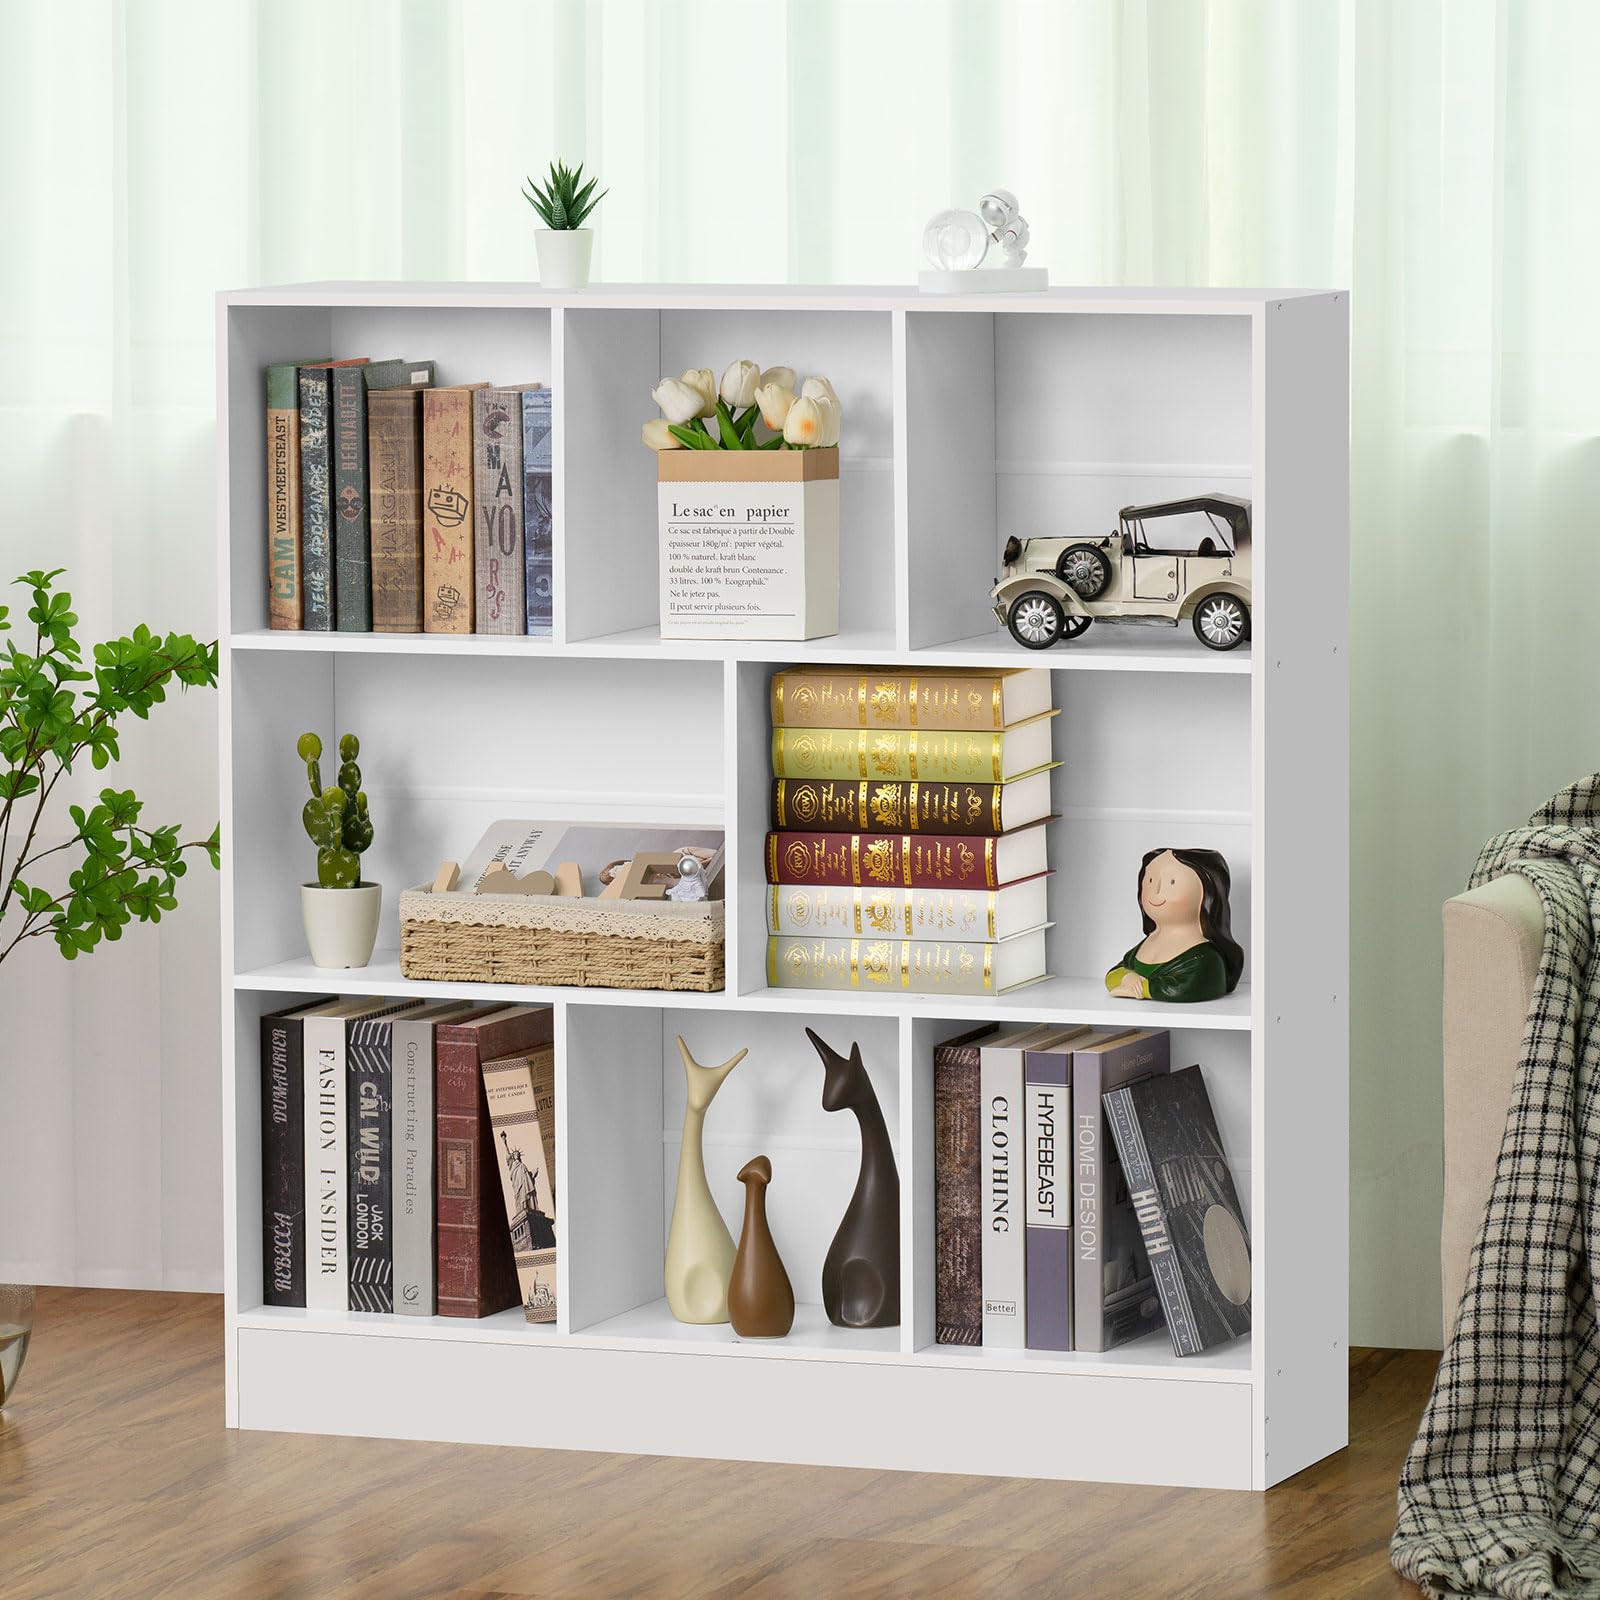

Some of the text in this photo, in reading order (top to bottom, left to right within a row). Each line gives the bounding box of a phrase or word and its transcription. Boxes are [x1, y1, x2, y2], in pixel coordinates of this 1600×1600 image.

[273, 415, 295, 600] CAM WESTMEETSEAST
[672, 503, 690, 517] Le
[719, 507, 736, 517] en
[746, 504, 790, 521] papier
[668, 527, 678, 535] Ce
[692, 527, 701, 535] est
[702, 526, 732, 537] fabriqué
[739, 527, 758, 537] partir
[759, 527, 768, 535] de
[769, 526, 795, 536] Double
[668, 540, 701, 549] épaisseur
[734, 540, 756, 549] papier
[669, 553, 681, 561] 100
[683, 553, 690, 561] %
[719, 552, 737, 561] kraft
[737, 552, 757, 561] blanc
[695, 565, 704, 574] de
[705, 565, 722, 574] kraft
[723, 566, 741, 574] brun
[669, 577, 678, 585] 33
[700, 577, 714, 585] 100
[714, 577, 721, 585] %
[670, 589, 681, 598] Ne
[681, 589, 689, 598] le
[689, 589, 705, 599] jetez
[670, 602, 676, 610] Il
[677, 603, 692, 612] peut
[693, 602, 713, 611] servir
[714, 602, 746, 612] plusieurs
[800, 795, 811, 812] RW
[792, 851, 803, 868] RW
[874, 854, 882, 868] RW
[319, 1048, 336, 1152] FASHION
[406, 1041, 418, 1215] Constructing Paradies
[1037, 1092, 1055, 1218] HYPEBEAST
[1079, 1114, 1095, 1179] HOME
[991, 1095, 1009, 1234] CLOTHING
[356, 1193, 369, 1249] LONDON
[371, 1204, 384, 1241] JACK
[274, 1211, 291, 1292] REBECCA
[1132, 1187, 1172, 1256] HOTH
[1158, 1260, 1188, 1346] SYSTEM
[987, 1303, 1016, 1314] Better
